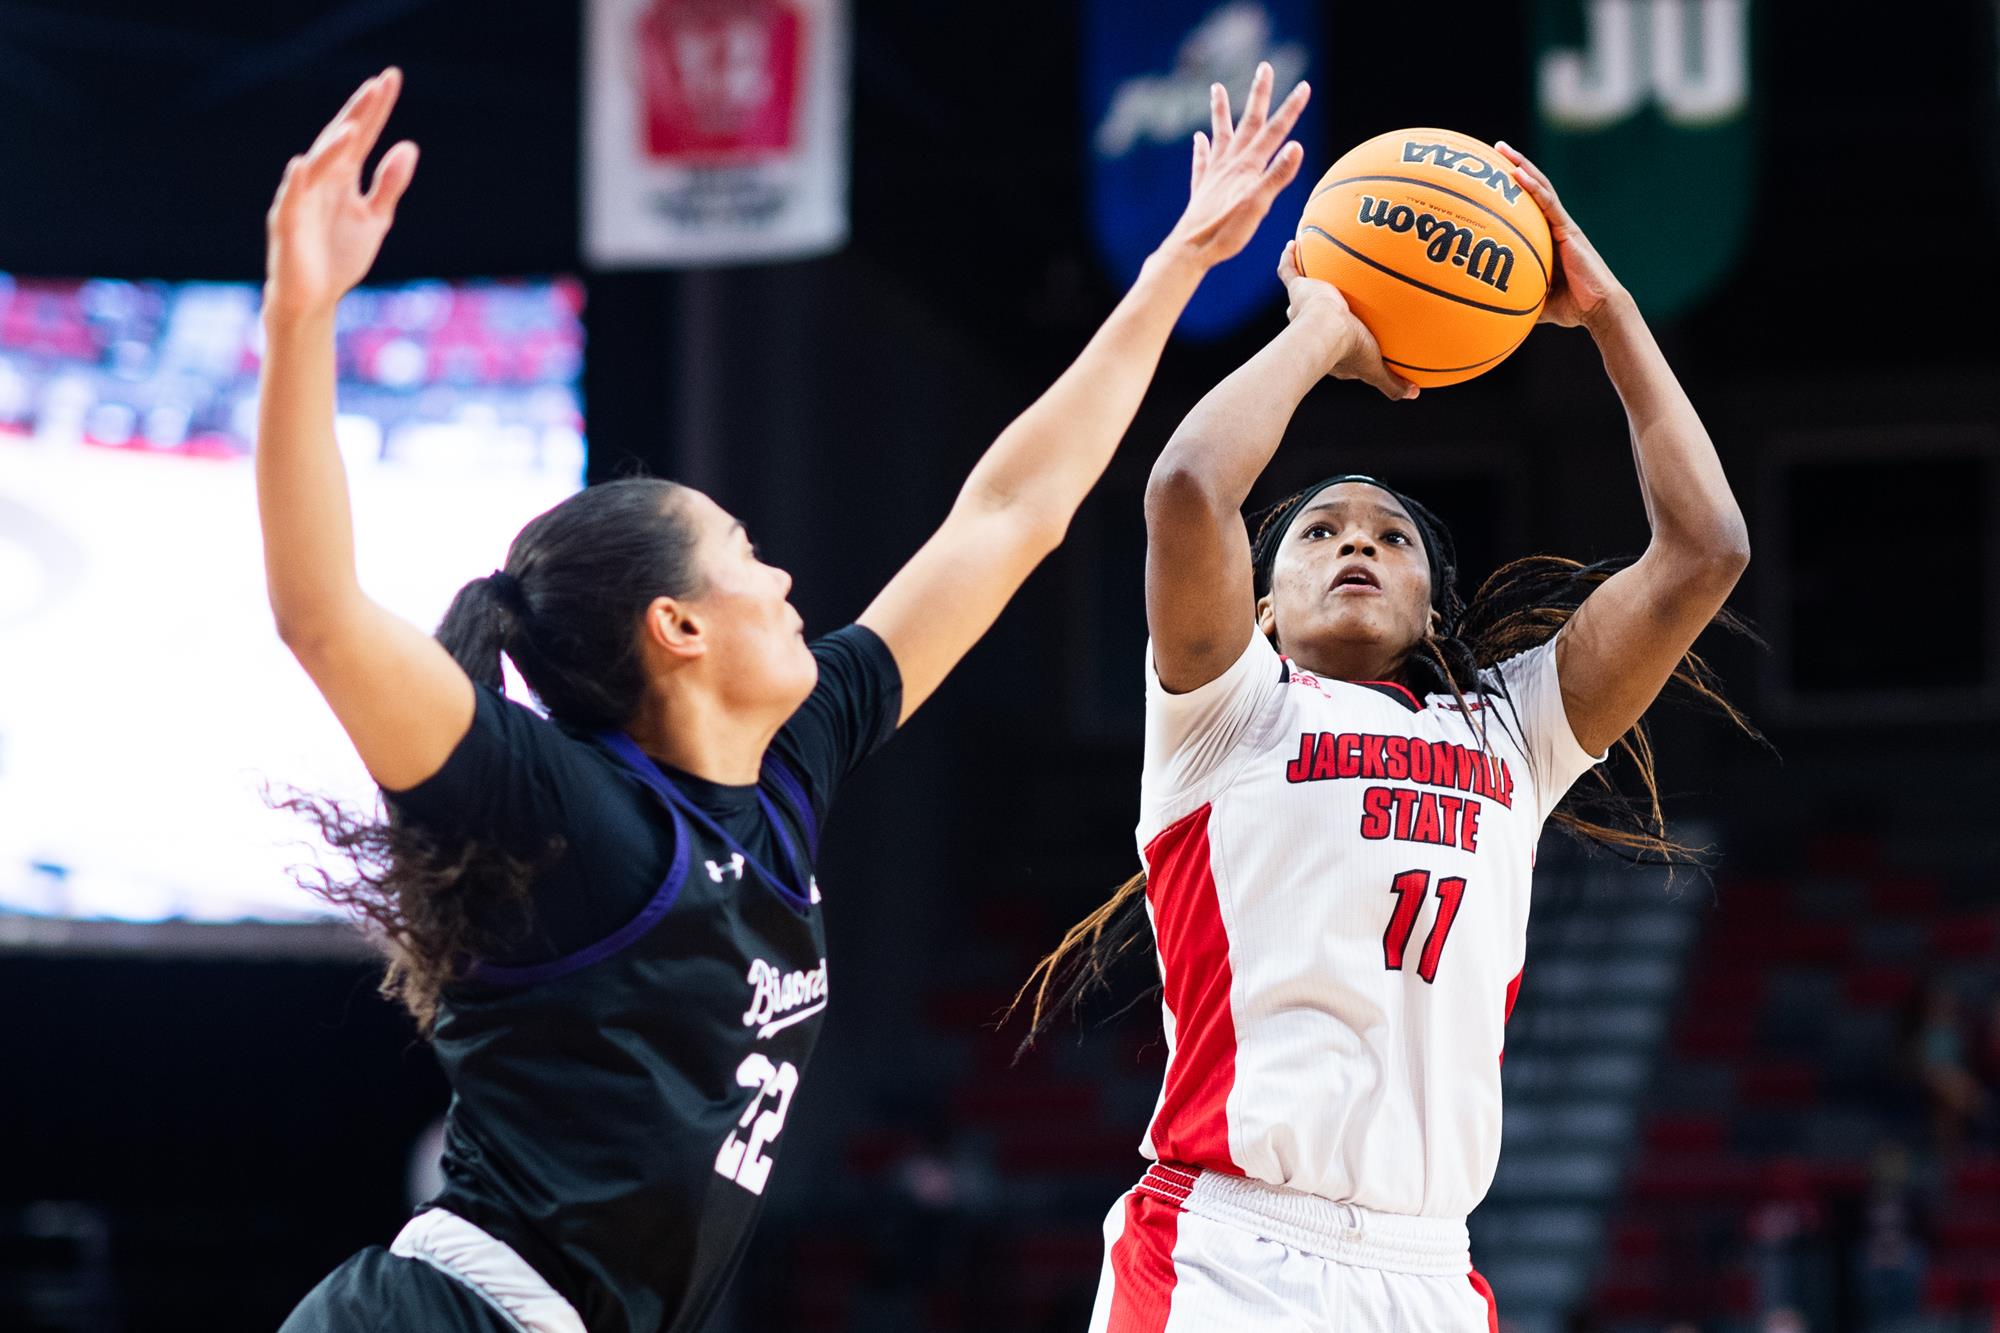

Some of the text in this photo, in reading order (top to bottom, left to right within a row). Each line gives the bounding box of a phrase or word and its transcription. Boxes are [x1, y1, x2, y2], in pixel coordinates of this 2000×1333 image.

[1540, 0, 1748, 123] JU
[1403, 141, 1524, 206] NCAA
[1357, 195, 1515, 293] Wilson
[1286, 731, 1514, 811] JACKSONVILLE
[1360, 786, 1481, 854] STATE
[1382, 868, 1467, 984] 11
[714, 1052, 799, 1196] 22
